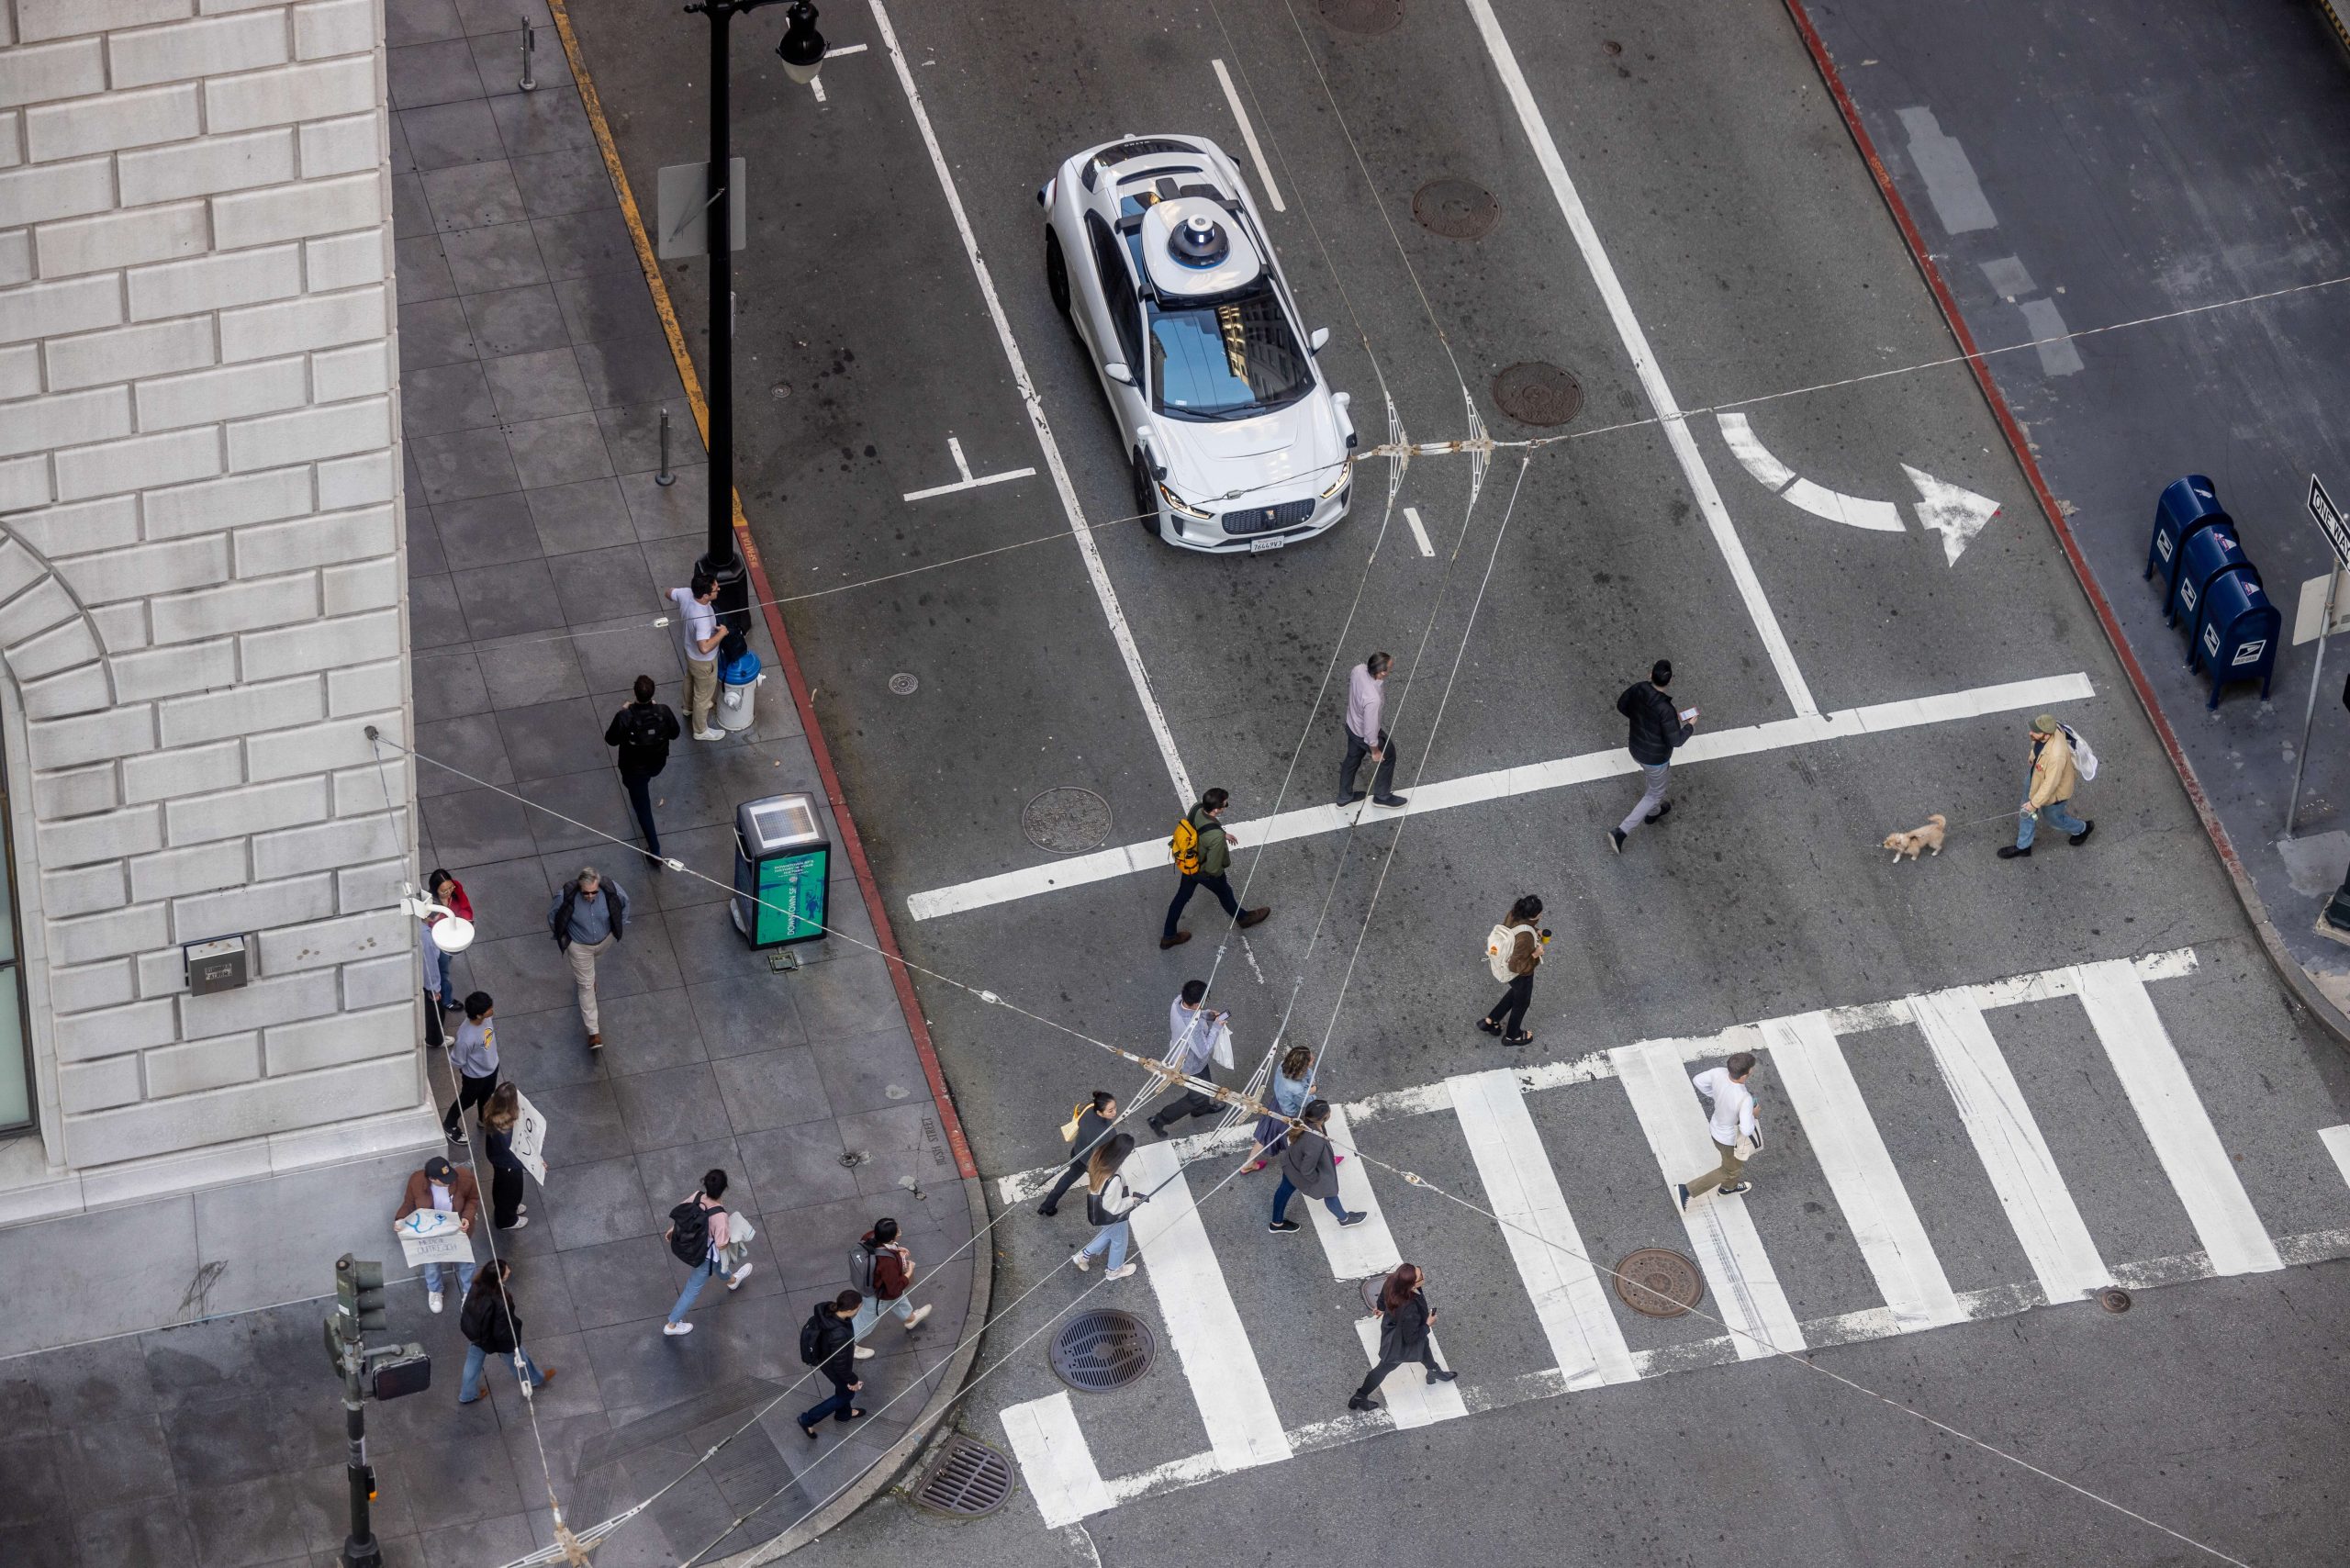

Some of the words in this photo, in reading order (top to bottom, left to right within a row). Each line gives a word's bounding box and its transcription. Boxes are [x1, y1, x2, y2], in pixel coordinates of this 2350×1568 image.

[2315, 494, 2333, 530] ONE
[1254, 541, 1282, 551] 76449V3
[789, 887, 797, 895] SF
[787, 896, 797, 935] DOWNTOWN
[922, 1117, 939, 1145] STREET
[417, 1243, 457, 1255] OUTREACH
